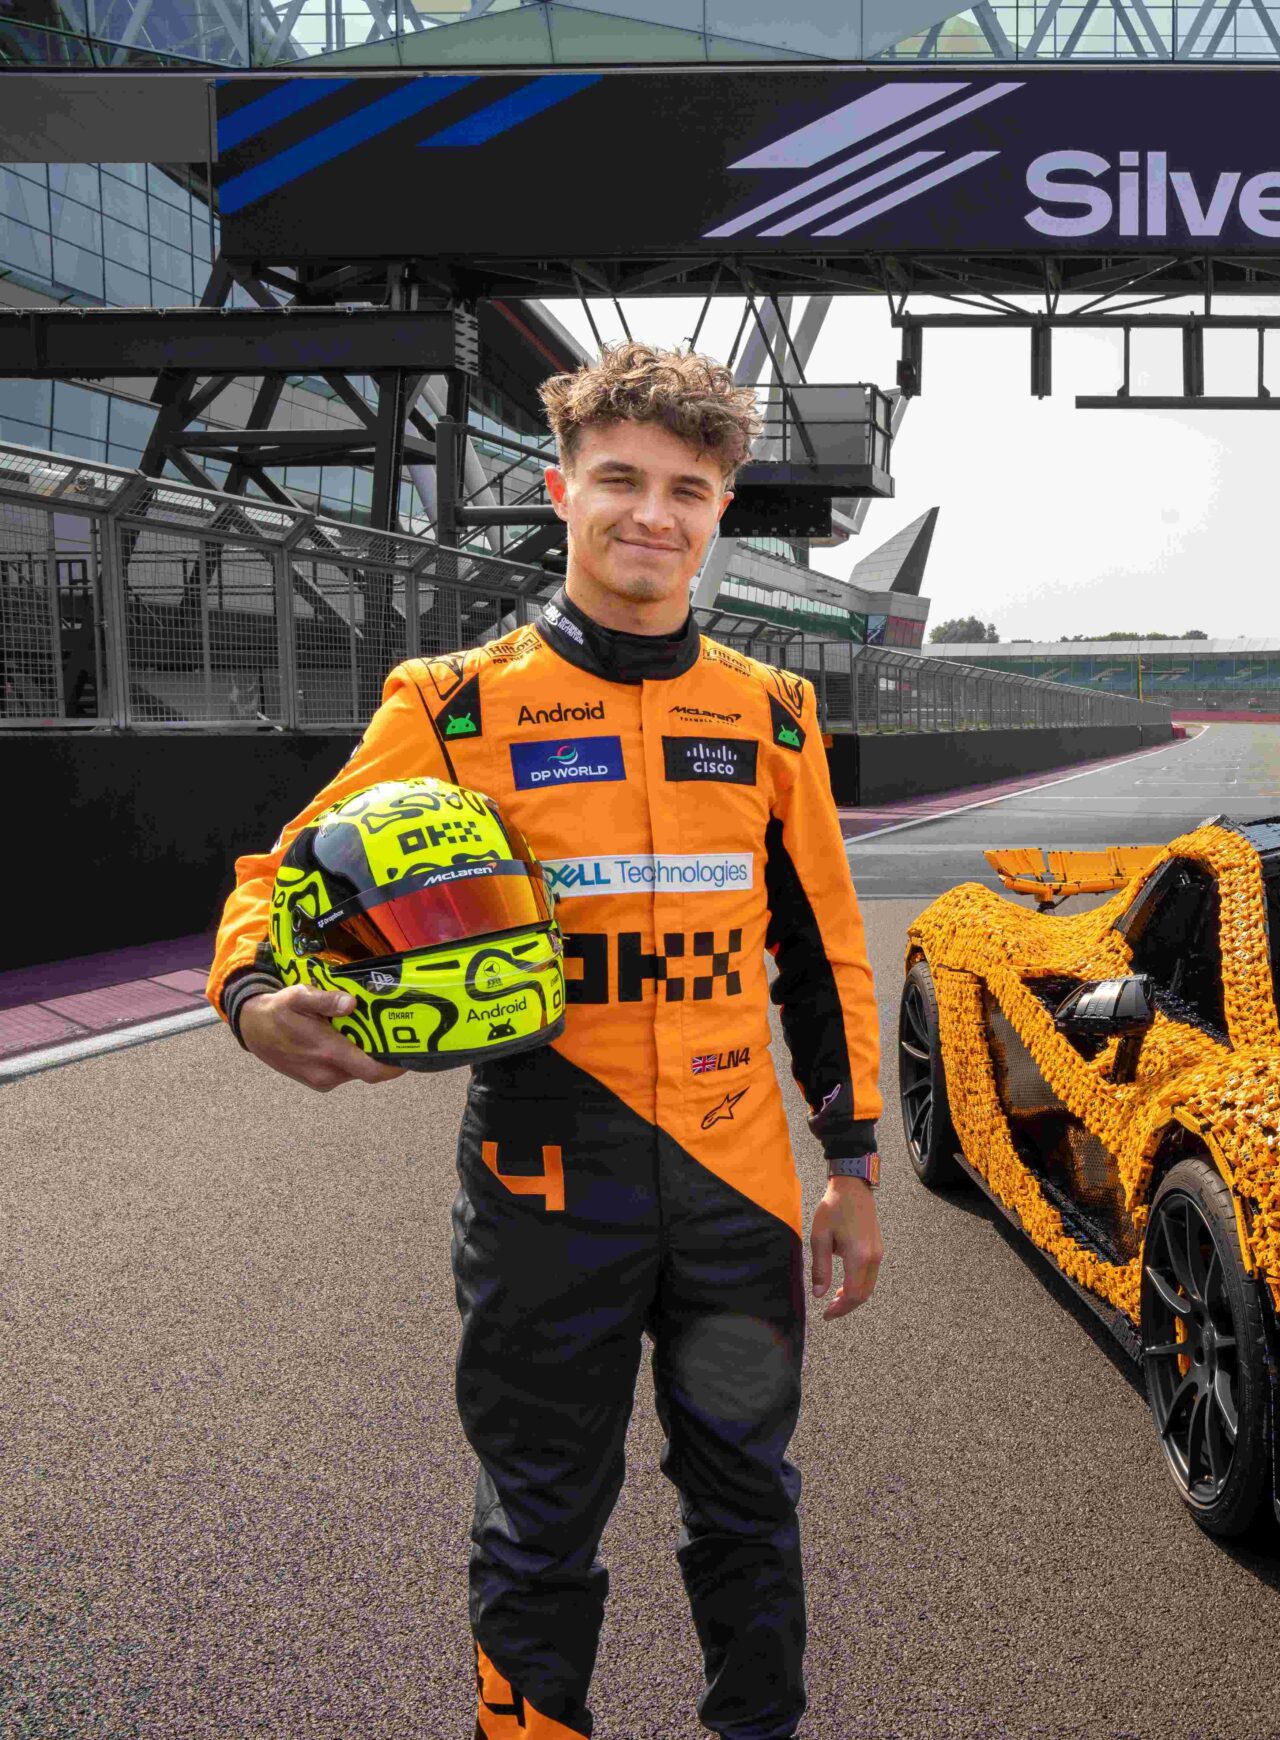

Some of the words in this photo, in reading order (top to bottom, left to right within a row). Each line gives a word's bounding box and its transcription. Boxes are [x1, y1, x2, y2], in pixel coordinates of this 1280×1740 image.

[489, 638, 533, 655] Hilton
[518, 700, 605, 726] Android
[668, 706, 735, 723] McLaren
[531, 770, 551, 781] DP
[553, 765, 608, 779] WORLD
[693, 762, 735, 775] CISCO
[397, 821, 482, 855] OKX
[423, 866, 493, 887] McLaren
[614, 859, 748, 888] Technologies
[466, 996, 527, 1023] Android
[717, 1047, 751, 1071] LN4
[482, 1141, 565, 1211] 4
